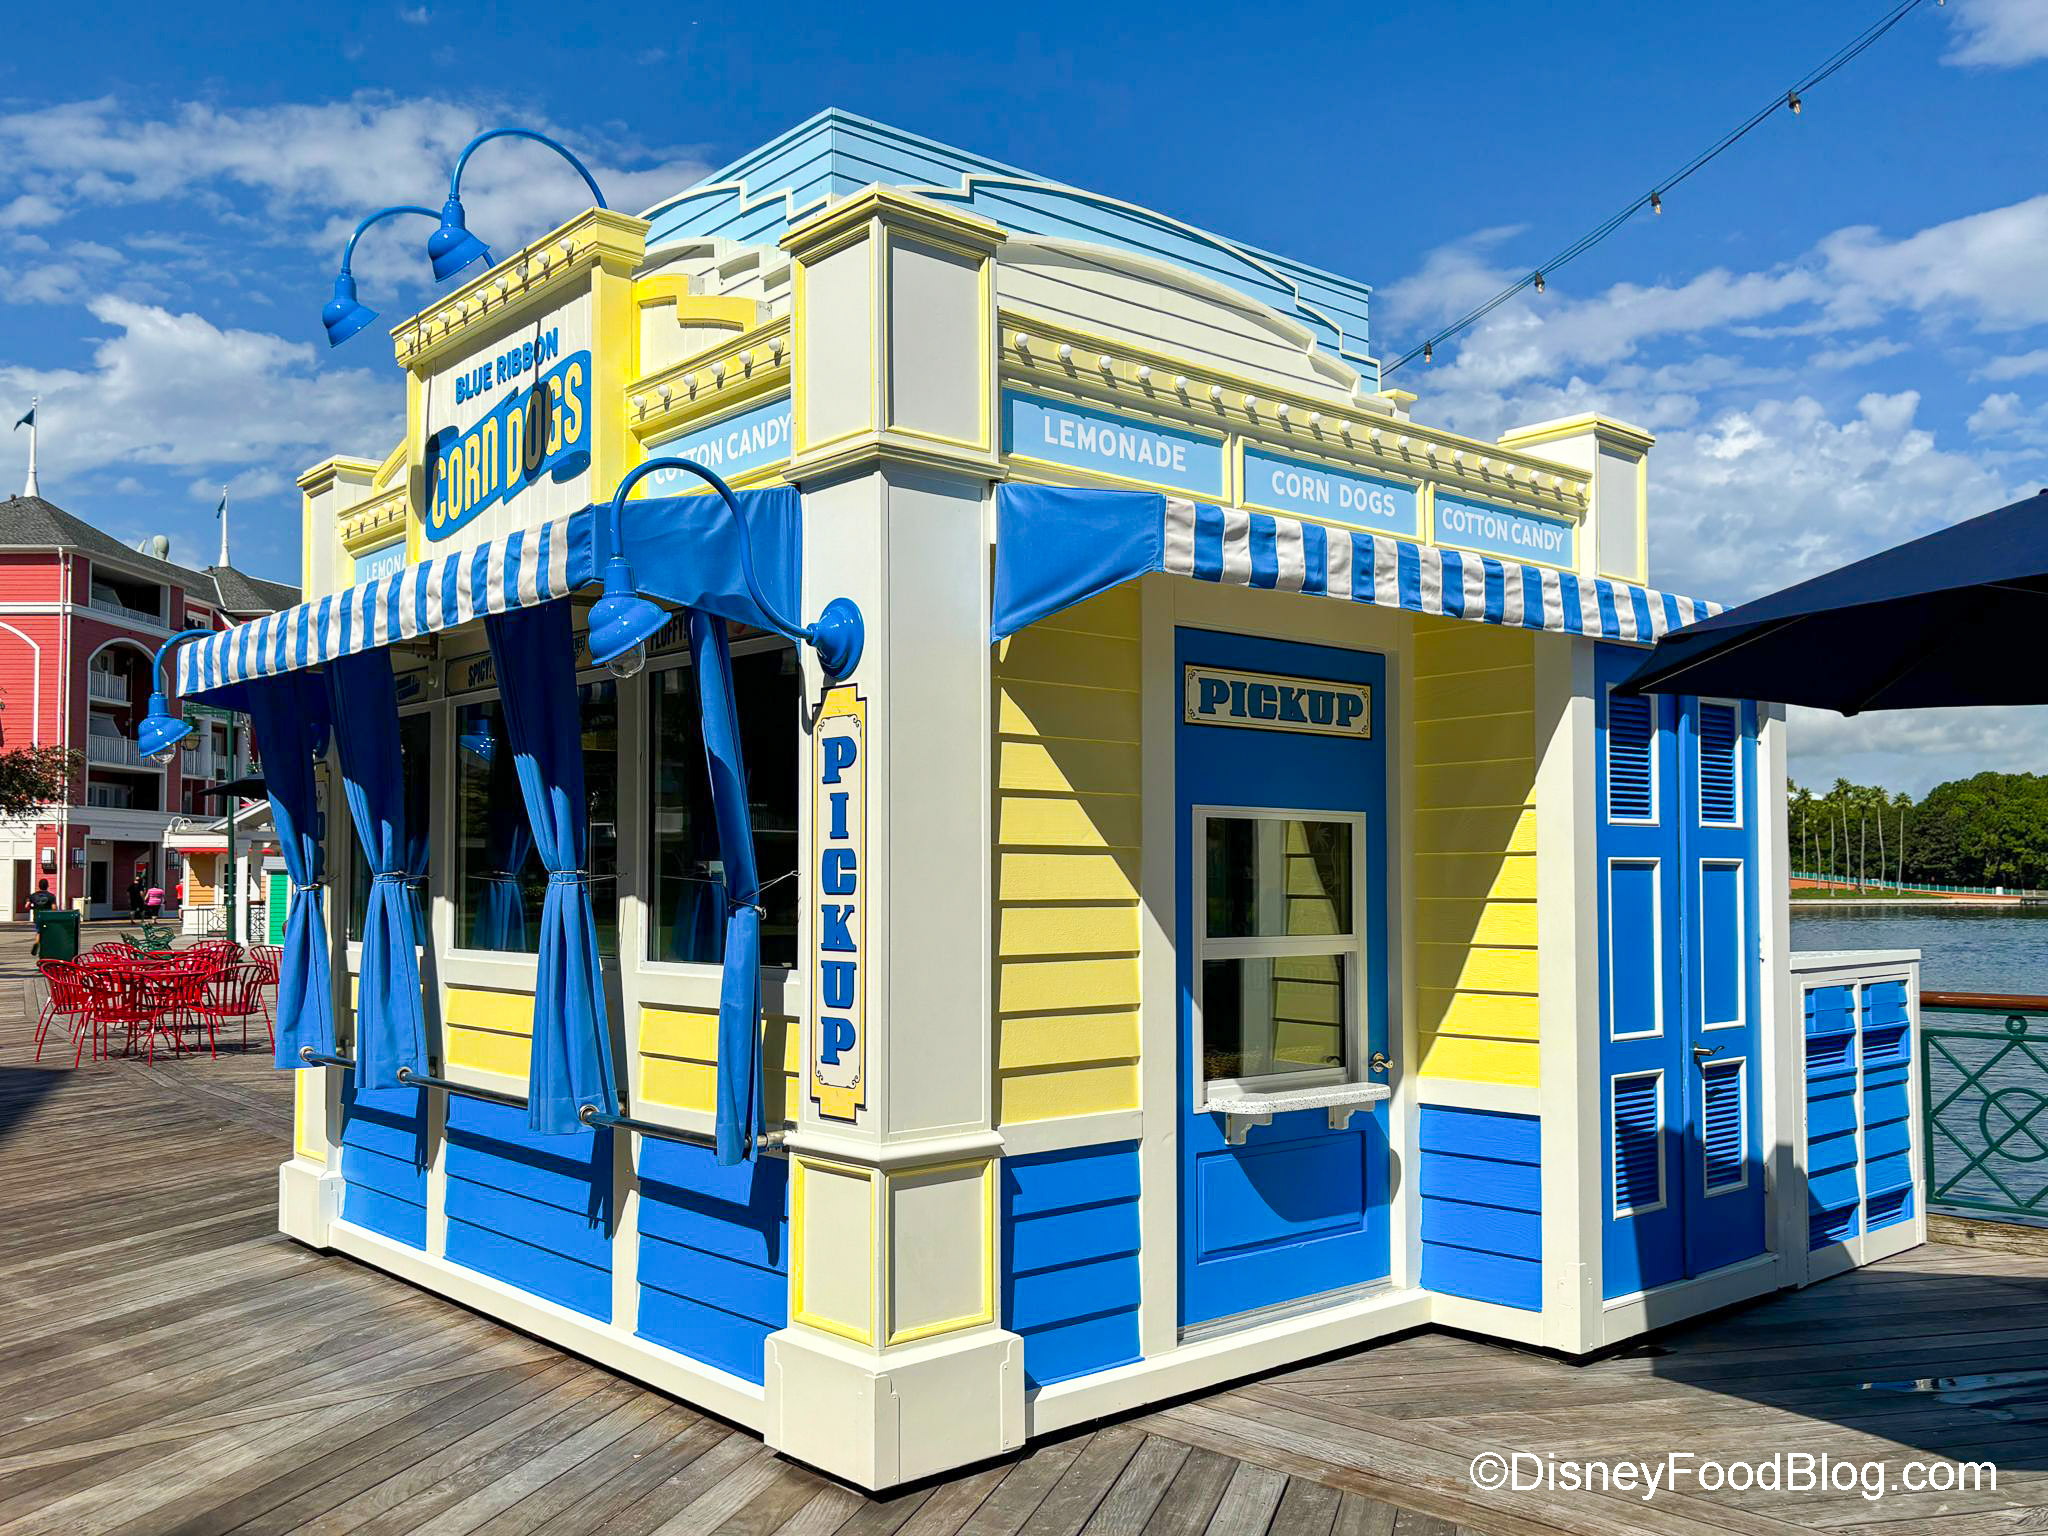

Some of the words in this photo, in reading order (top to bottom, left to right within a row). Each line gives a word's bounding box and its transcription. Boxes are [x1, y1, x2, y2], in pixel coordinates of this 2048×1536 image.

[455, 361, 493, 405] BLUE
[497, 327, 559, 385] RIBBON
[431, 416, 499, 529] CORN
[506, 361, 583, 490] DOGS
[726, 412, 792, 460] CANDY
[1044, 415, 1187, 472] LEMONADE
[1271, 470, 1330, 505] CORN
[1339, 483, 1396, 517] DOGS
[1442, 507, 1508, 542] COTTON
[1511, 523, 1564, 553] CANDY
[1198, 677, 1364, 727] PICKUP
[820, 735, 858, 1066] PICKUP
